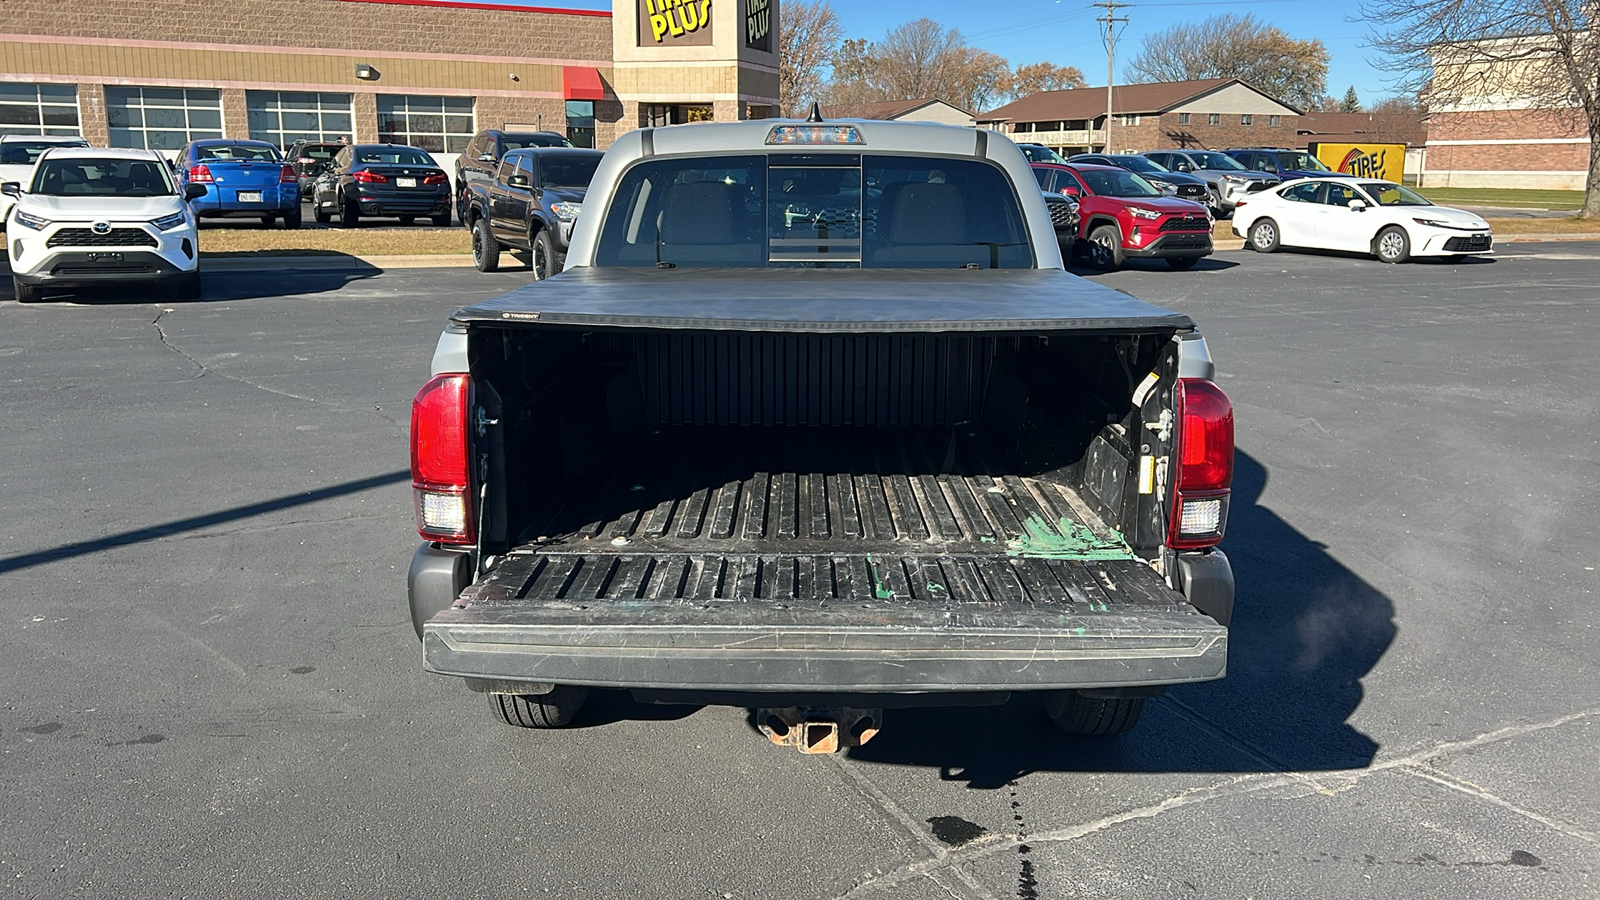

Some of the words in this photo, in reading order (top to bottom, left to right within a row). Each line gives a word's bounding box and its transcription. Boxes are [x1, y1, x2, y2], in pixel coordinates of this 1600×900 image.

[650, 0, 711, 42] PLUS
[748, 8, 769, 43] PLUS
[1349, 149, 1386, 178] TIRES
